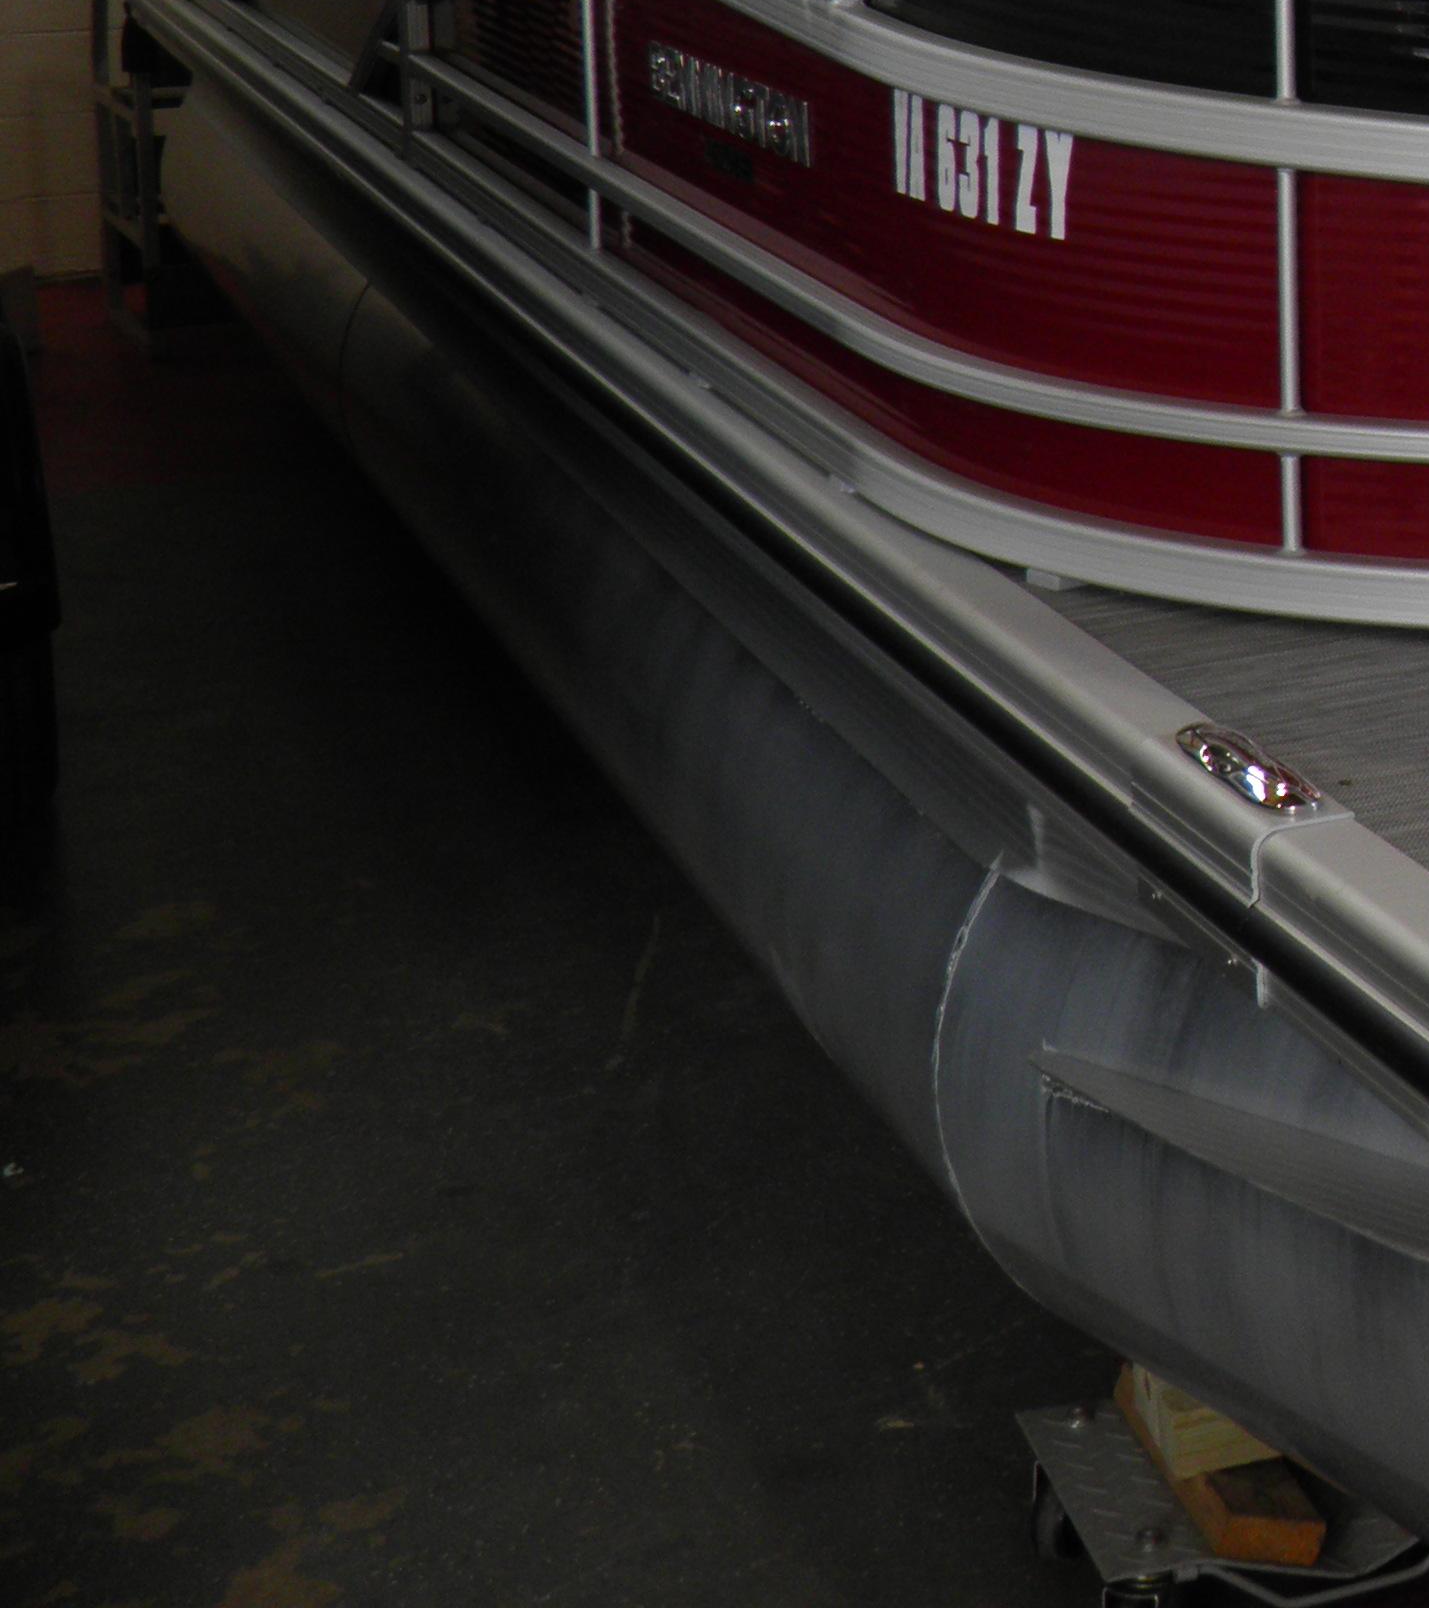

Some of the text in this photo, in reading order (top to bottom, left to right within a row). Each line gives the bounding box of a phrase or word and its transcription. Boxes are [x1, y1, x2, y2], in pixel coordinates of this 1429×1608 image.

[893, 87, 1074, 241] VA 631 ZY
